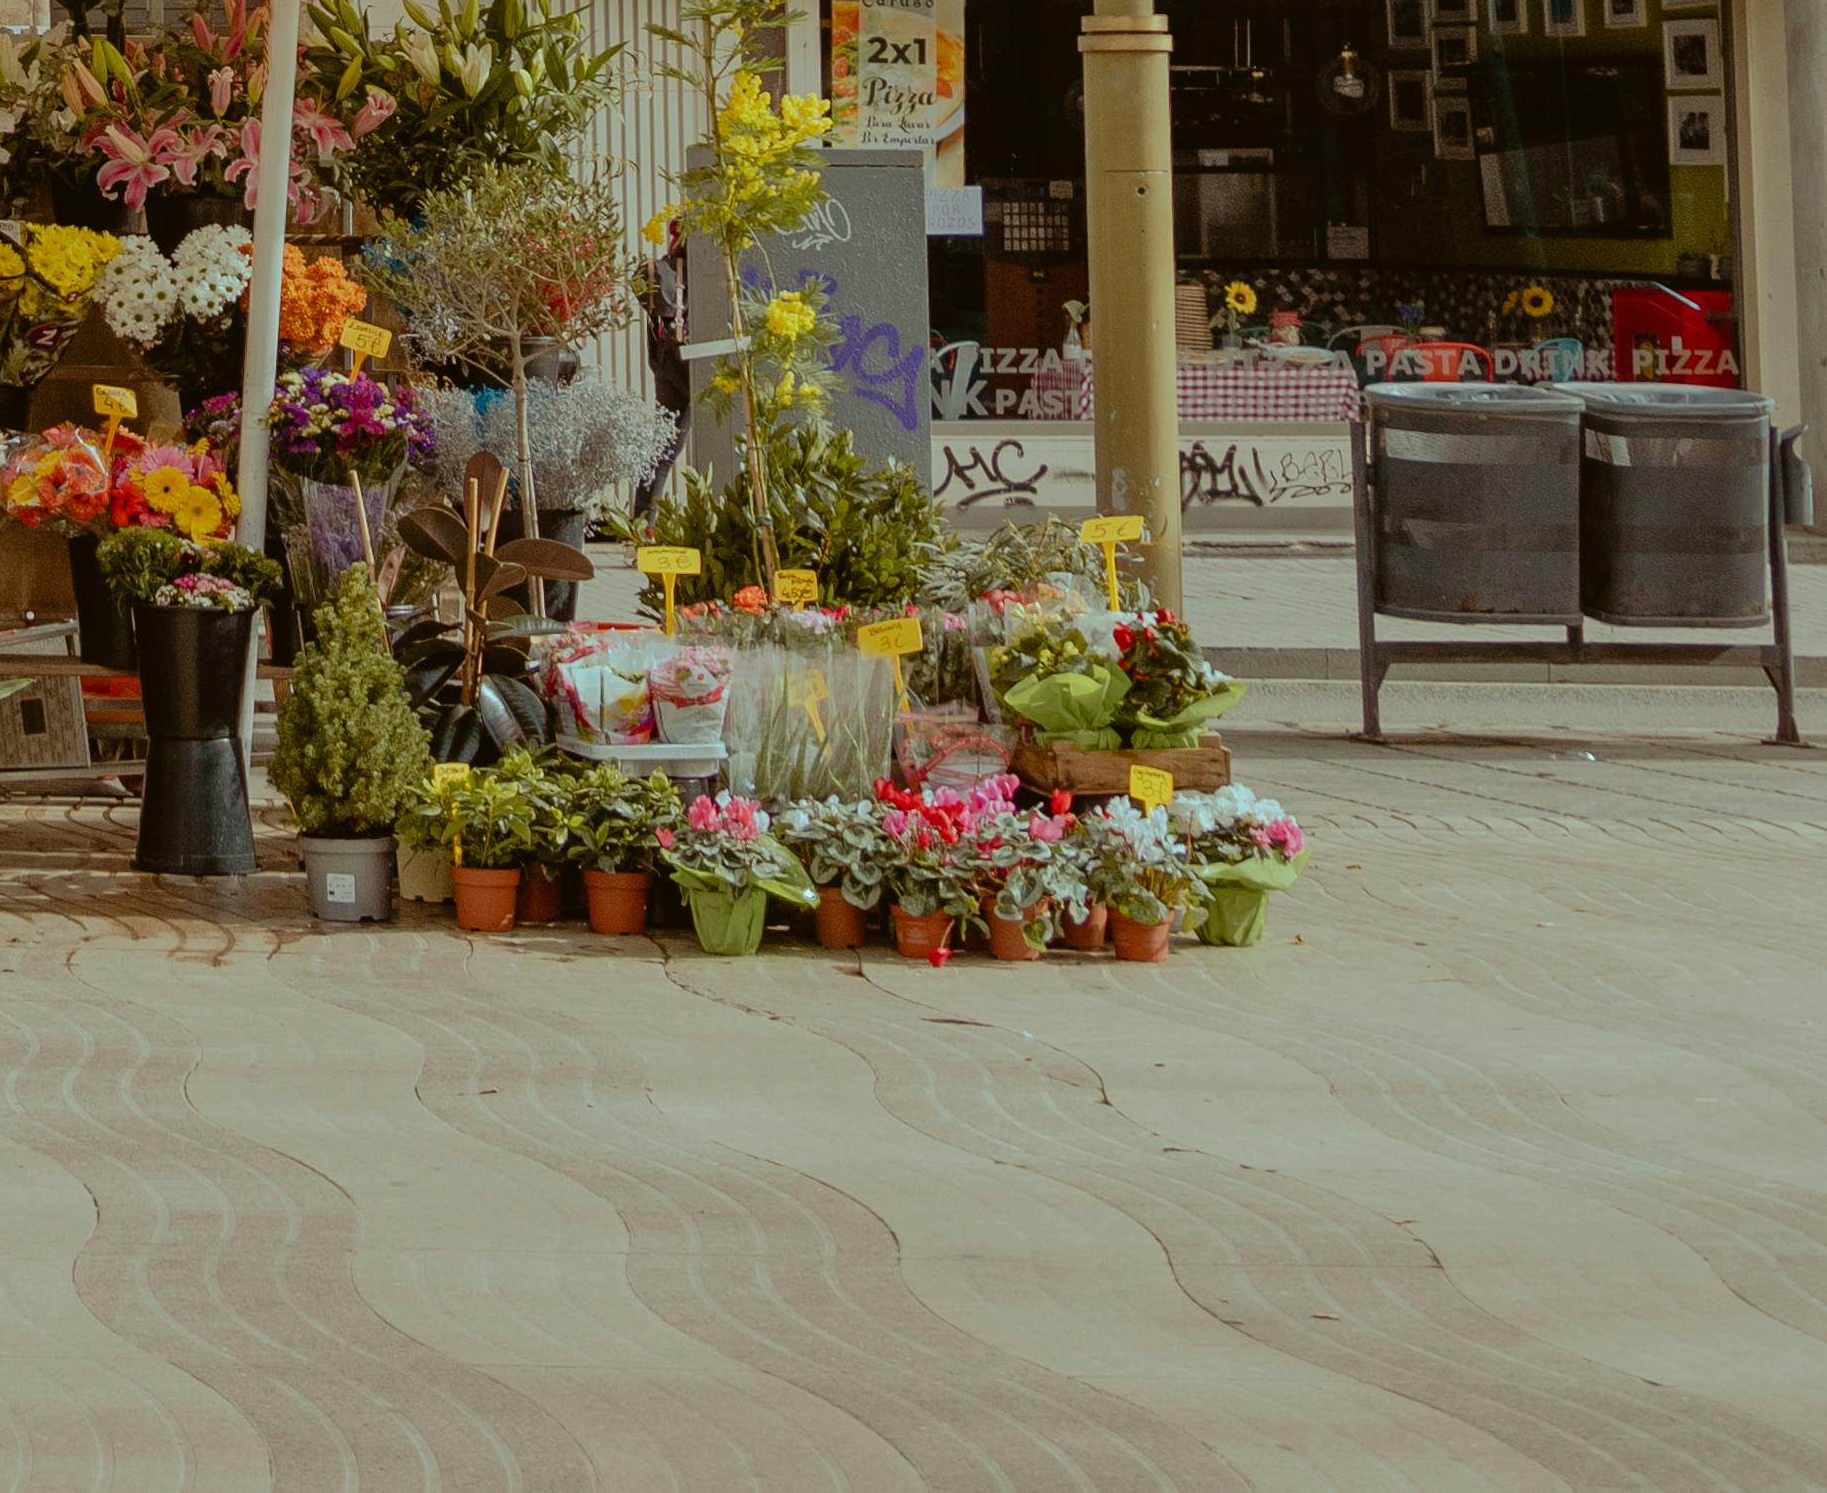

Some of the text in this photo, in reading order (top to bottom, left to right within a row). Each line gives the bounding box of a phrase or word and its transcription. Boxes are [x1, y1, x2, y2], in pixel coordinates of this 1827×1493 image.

[866, 36, 927, 66] 2x1
[862, 75, 936, 115] Pizza
[926, 216, 974, 229] ROZOS
[1363, 349, 1480, 375] PASTA
[1630, 349, 1738, 376] PIZZA
[992, 389, 1085, 416] PAST
